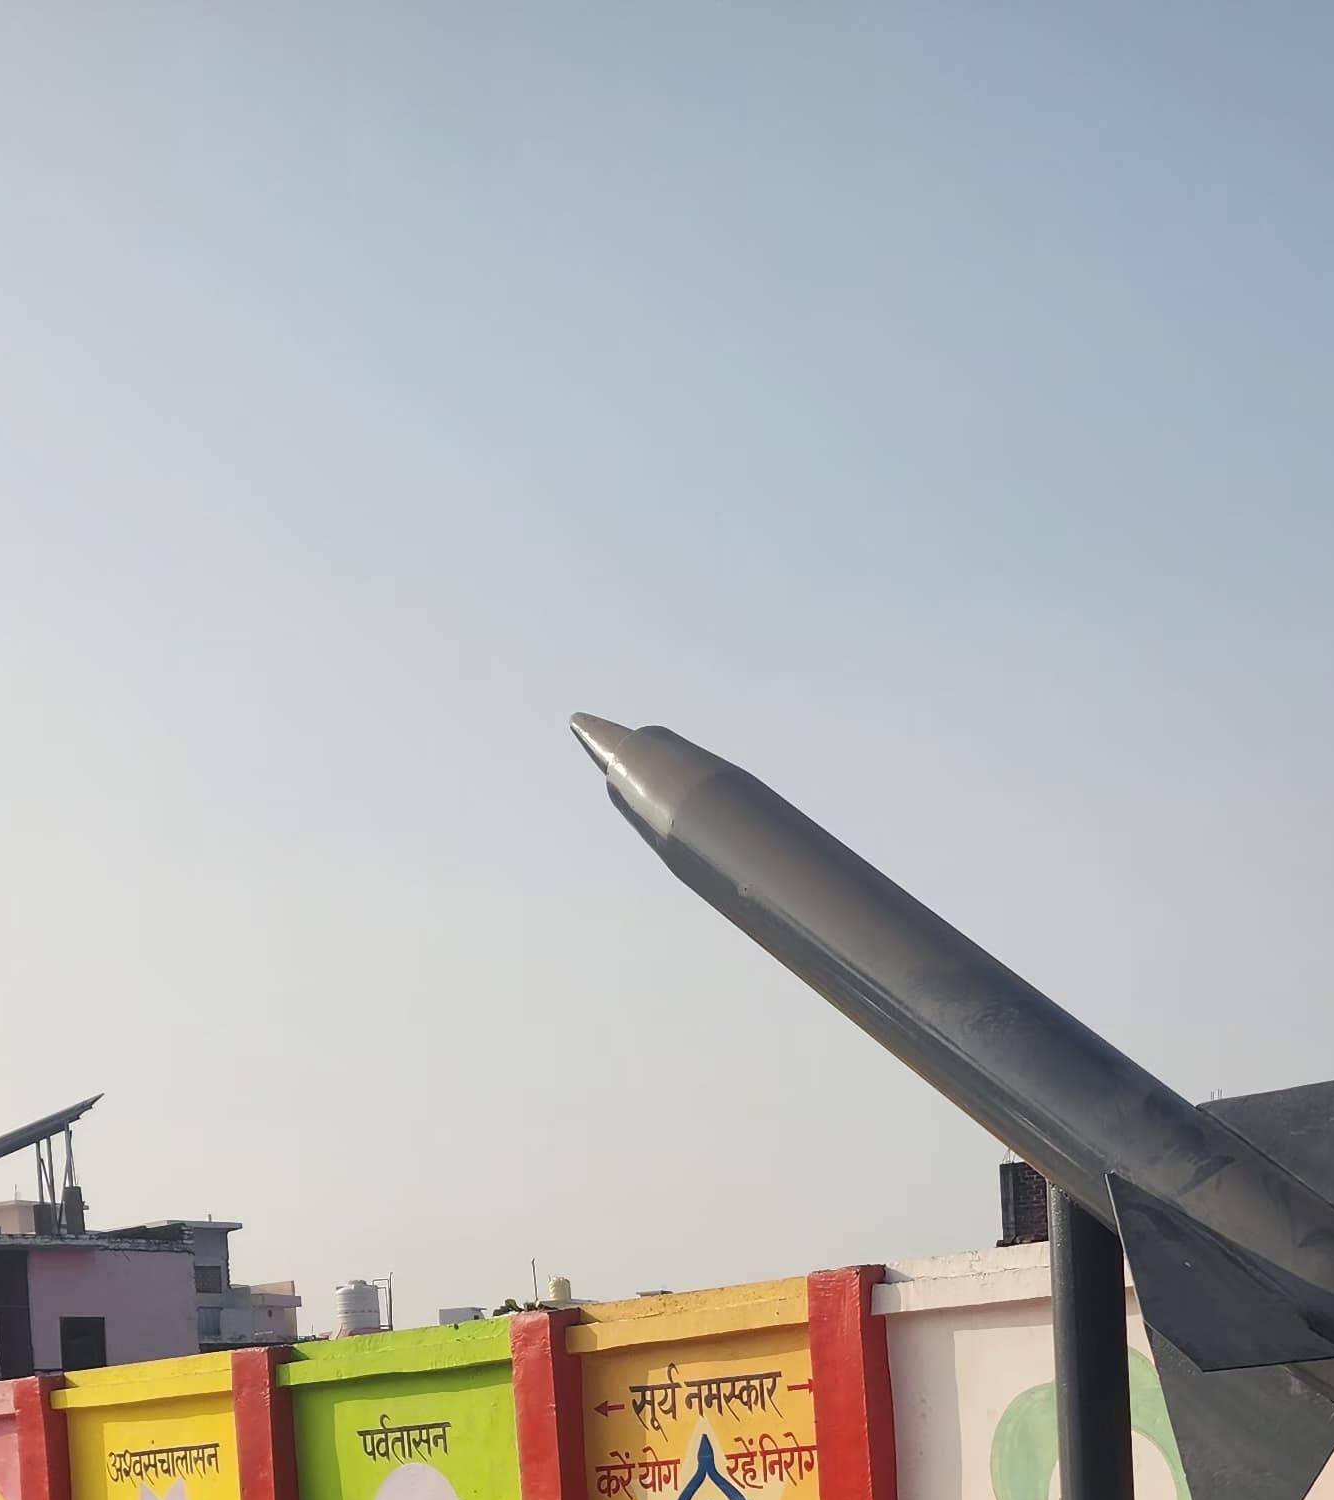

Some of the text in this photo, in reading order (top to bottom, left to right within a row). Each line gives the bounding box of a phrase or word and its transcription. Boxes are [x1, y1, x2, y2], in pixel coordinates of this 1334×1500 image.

[630, 1363, 783, 1441] सूर्य नमस्कार
[107, 1440, 220, 1486] अश्वसंचालासन
[357, 1415, 452, 1463] पर्वतासन
[595, 1451, 635, 1500] करें
[639, 1446, 680, 1492] योग
[725, 1437, 763, 1489] रहें
